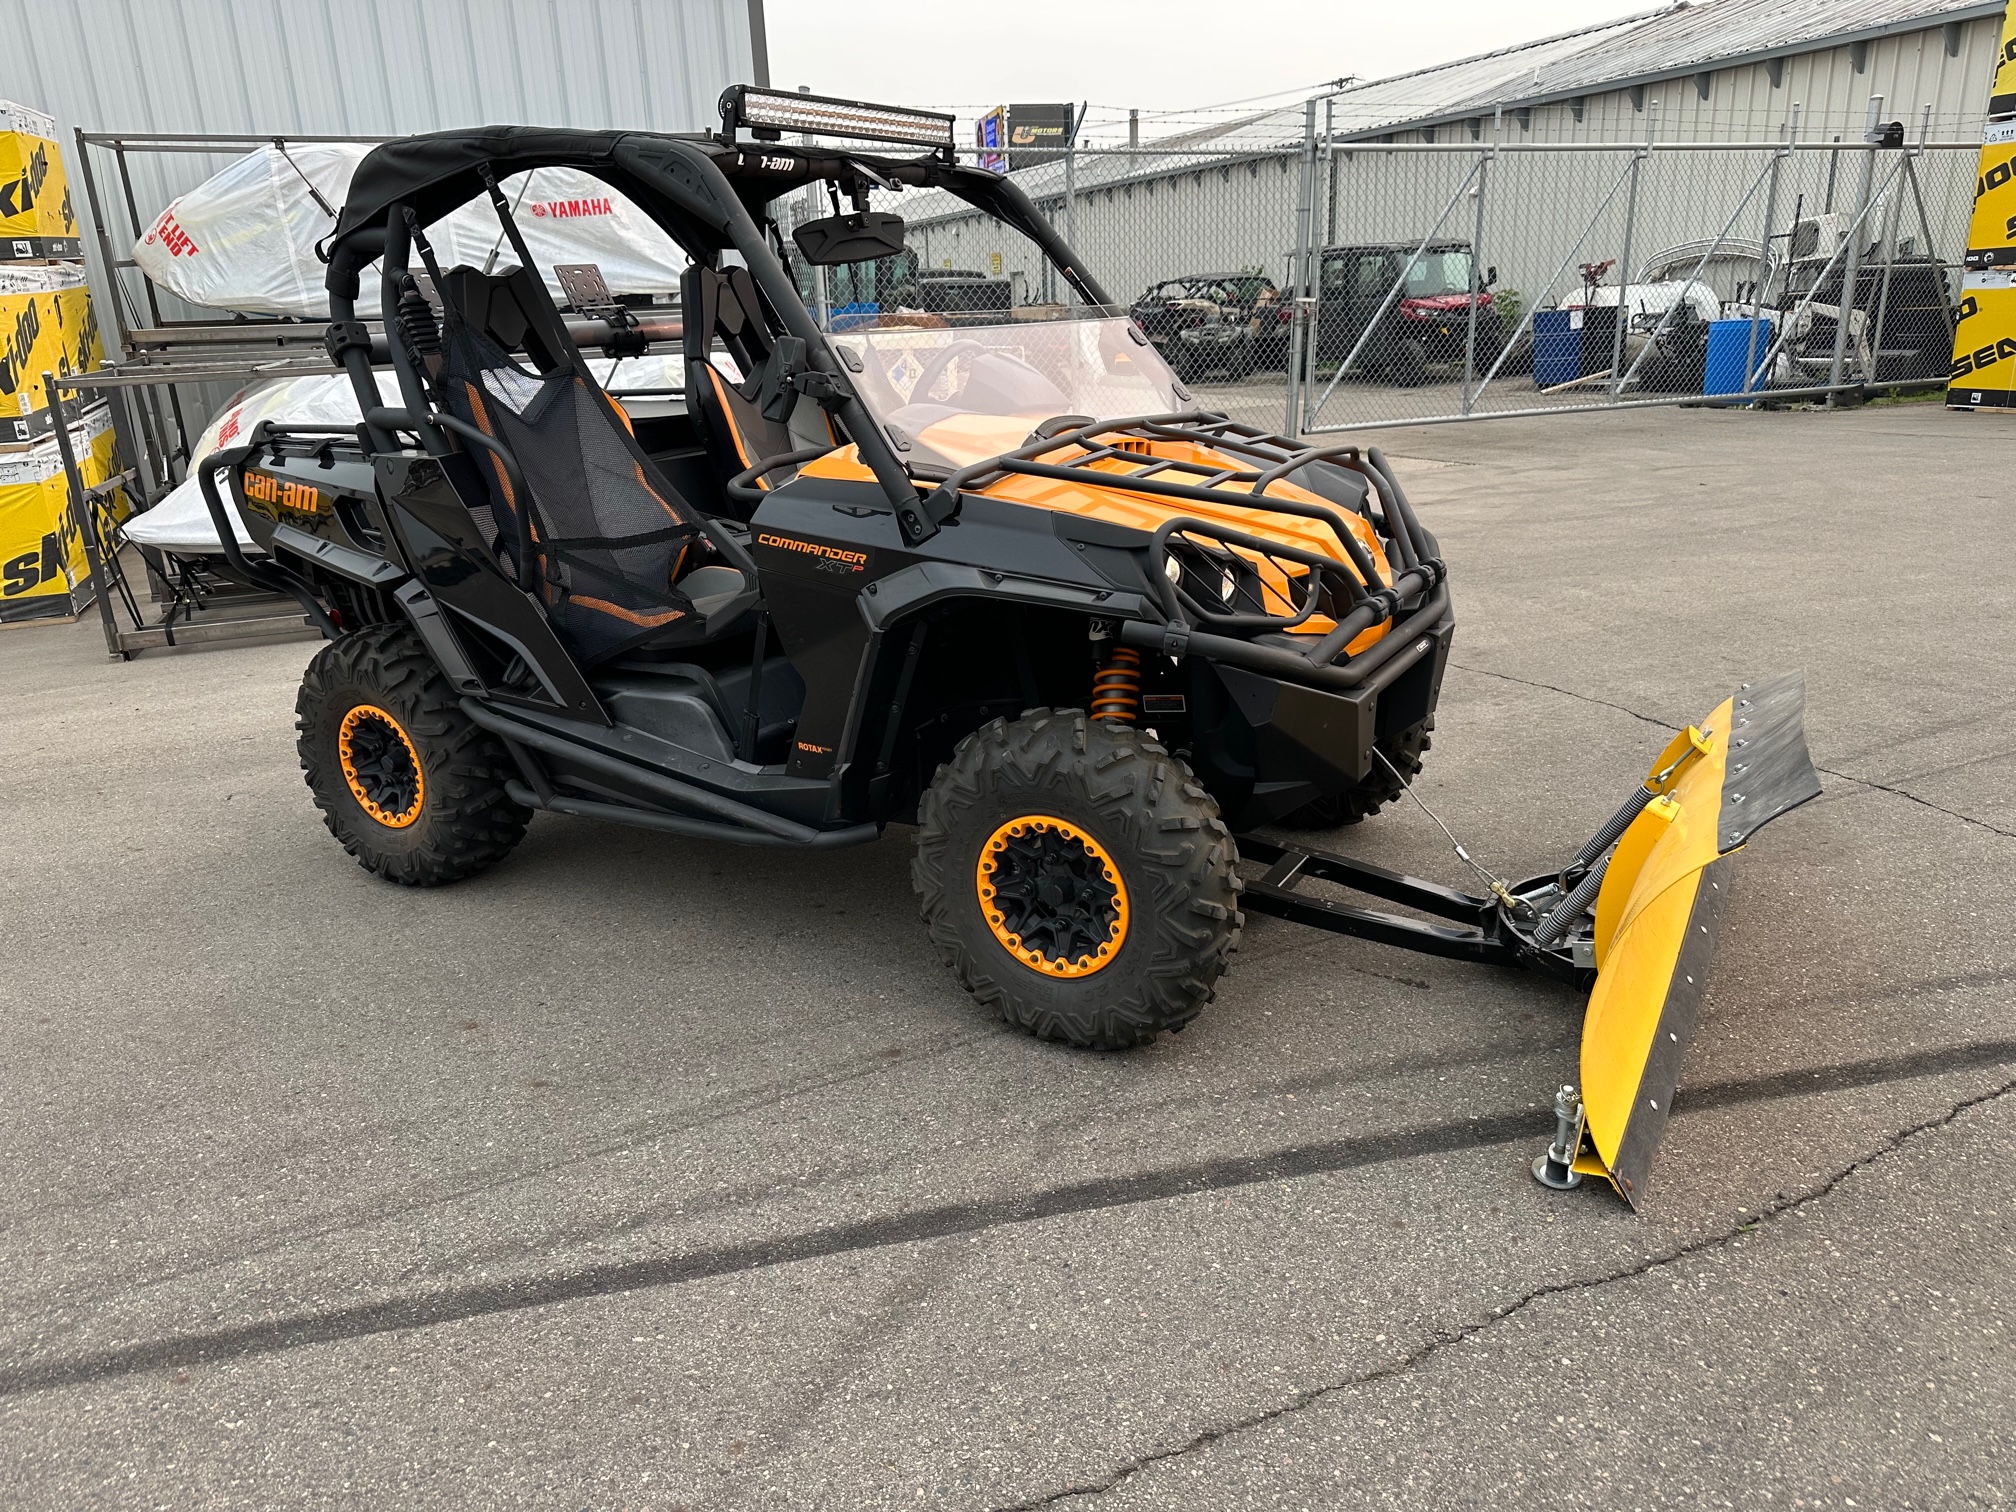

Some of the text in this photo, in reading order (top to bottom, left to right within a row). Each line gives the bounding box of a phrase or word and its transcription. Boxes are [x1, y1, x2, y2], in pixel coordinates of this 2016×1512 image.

[547, 198, 613, 218] YAMAHA
[158, 224, 182, 257] END
[170, 223, 200, 257] LIFT
[244, 470, 319, 512] can-am
[758, 533, 867, 564] COMMANDER
[797, 741, 823, 754] ROTAX
